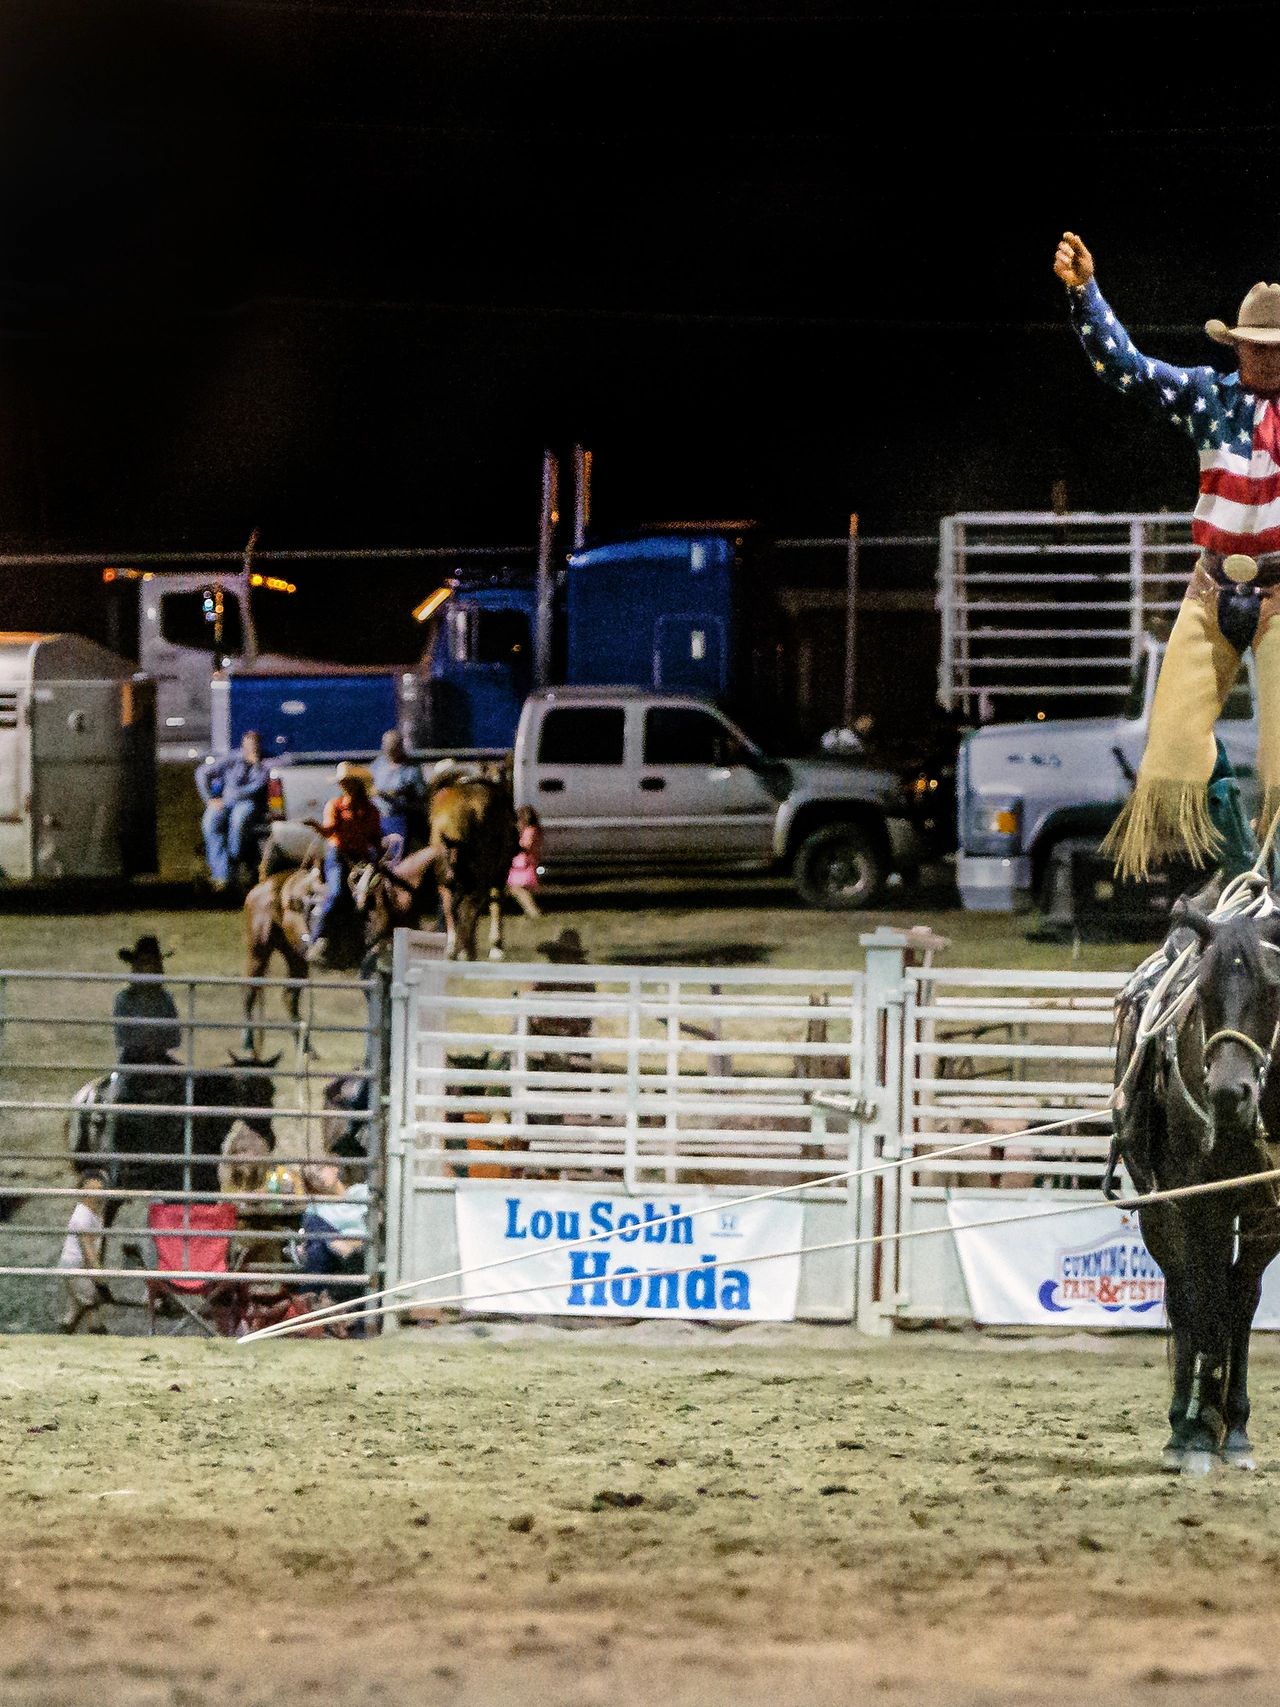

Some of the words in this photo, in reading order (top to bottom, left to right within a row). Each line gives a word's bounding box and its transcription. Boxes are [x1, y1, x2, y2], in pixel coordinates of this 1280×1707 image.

[504, 1197, 580, 1241] Lou
[589, 1200, 694, 1245] Sobh
[566, 1251, 752, 1311] Honda
